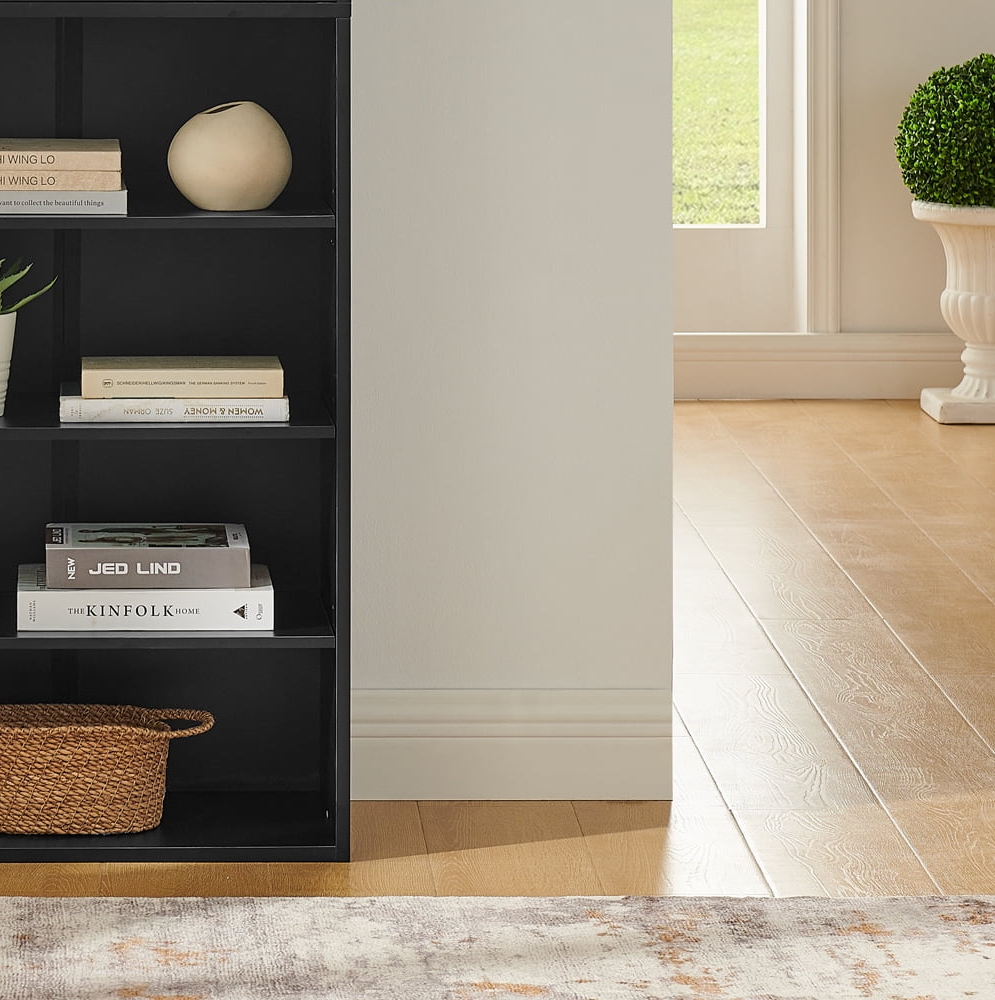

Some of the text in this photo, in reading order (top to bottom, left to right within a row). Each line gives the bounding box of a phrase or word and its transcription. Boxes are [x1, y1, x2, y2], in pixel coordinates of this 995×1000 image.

[8, 154, 38, 165] WING
[40, 154, 55, 165] LO
[8, 175, 38, 186] WING
[40, 175, 56, 186] LO
[83, 199, 105, 208] things
[184, 407, 217, 416] MONEY
[219, 407, 226, 416] &
[227, 407, 264, 416] WOMEN
[67, 557, 76, 580] NEW
[88, 562, 181, 575] JED LIND
[86, 604, 175, 617] KINFOLK
